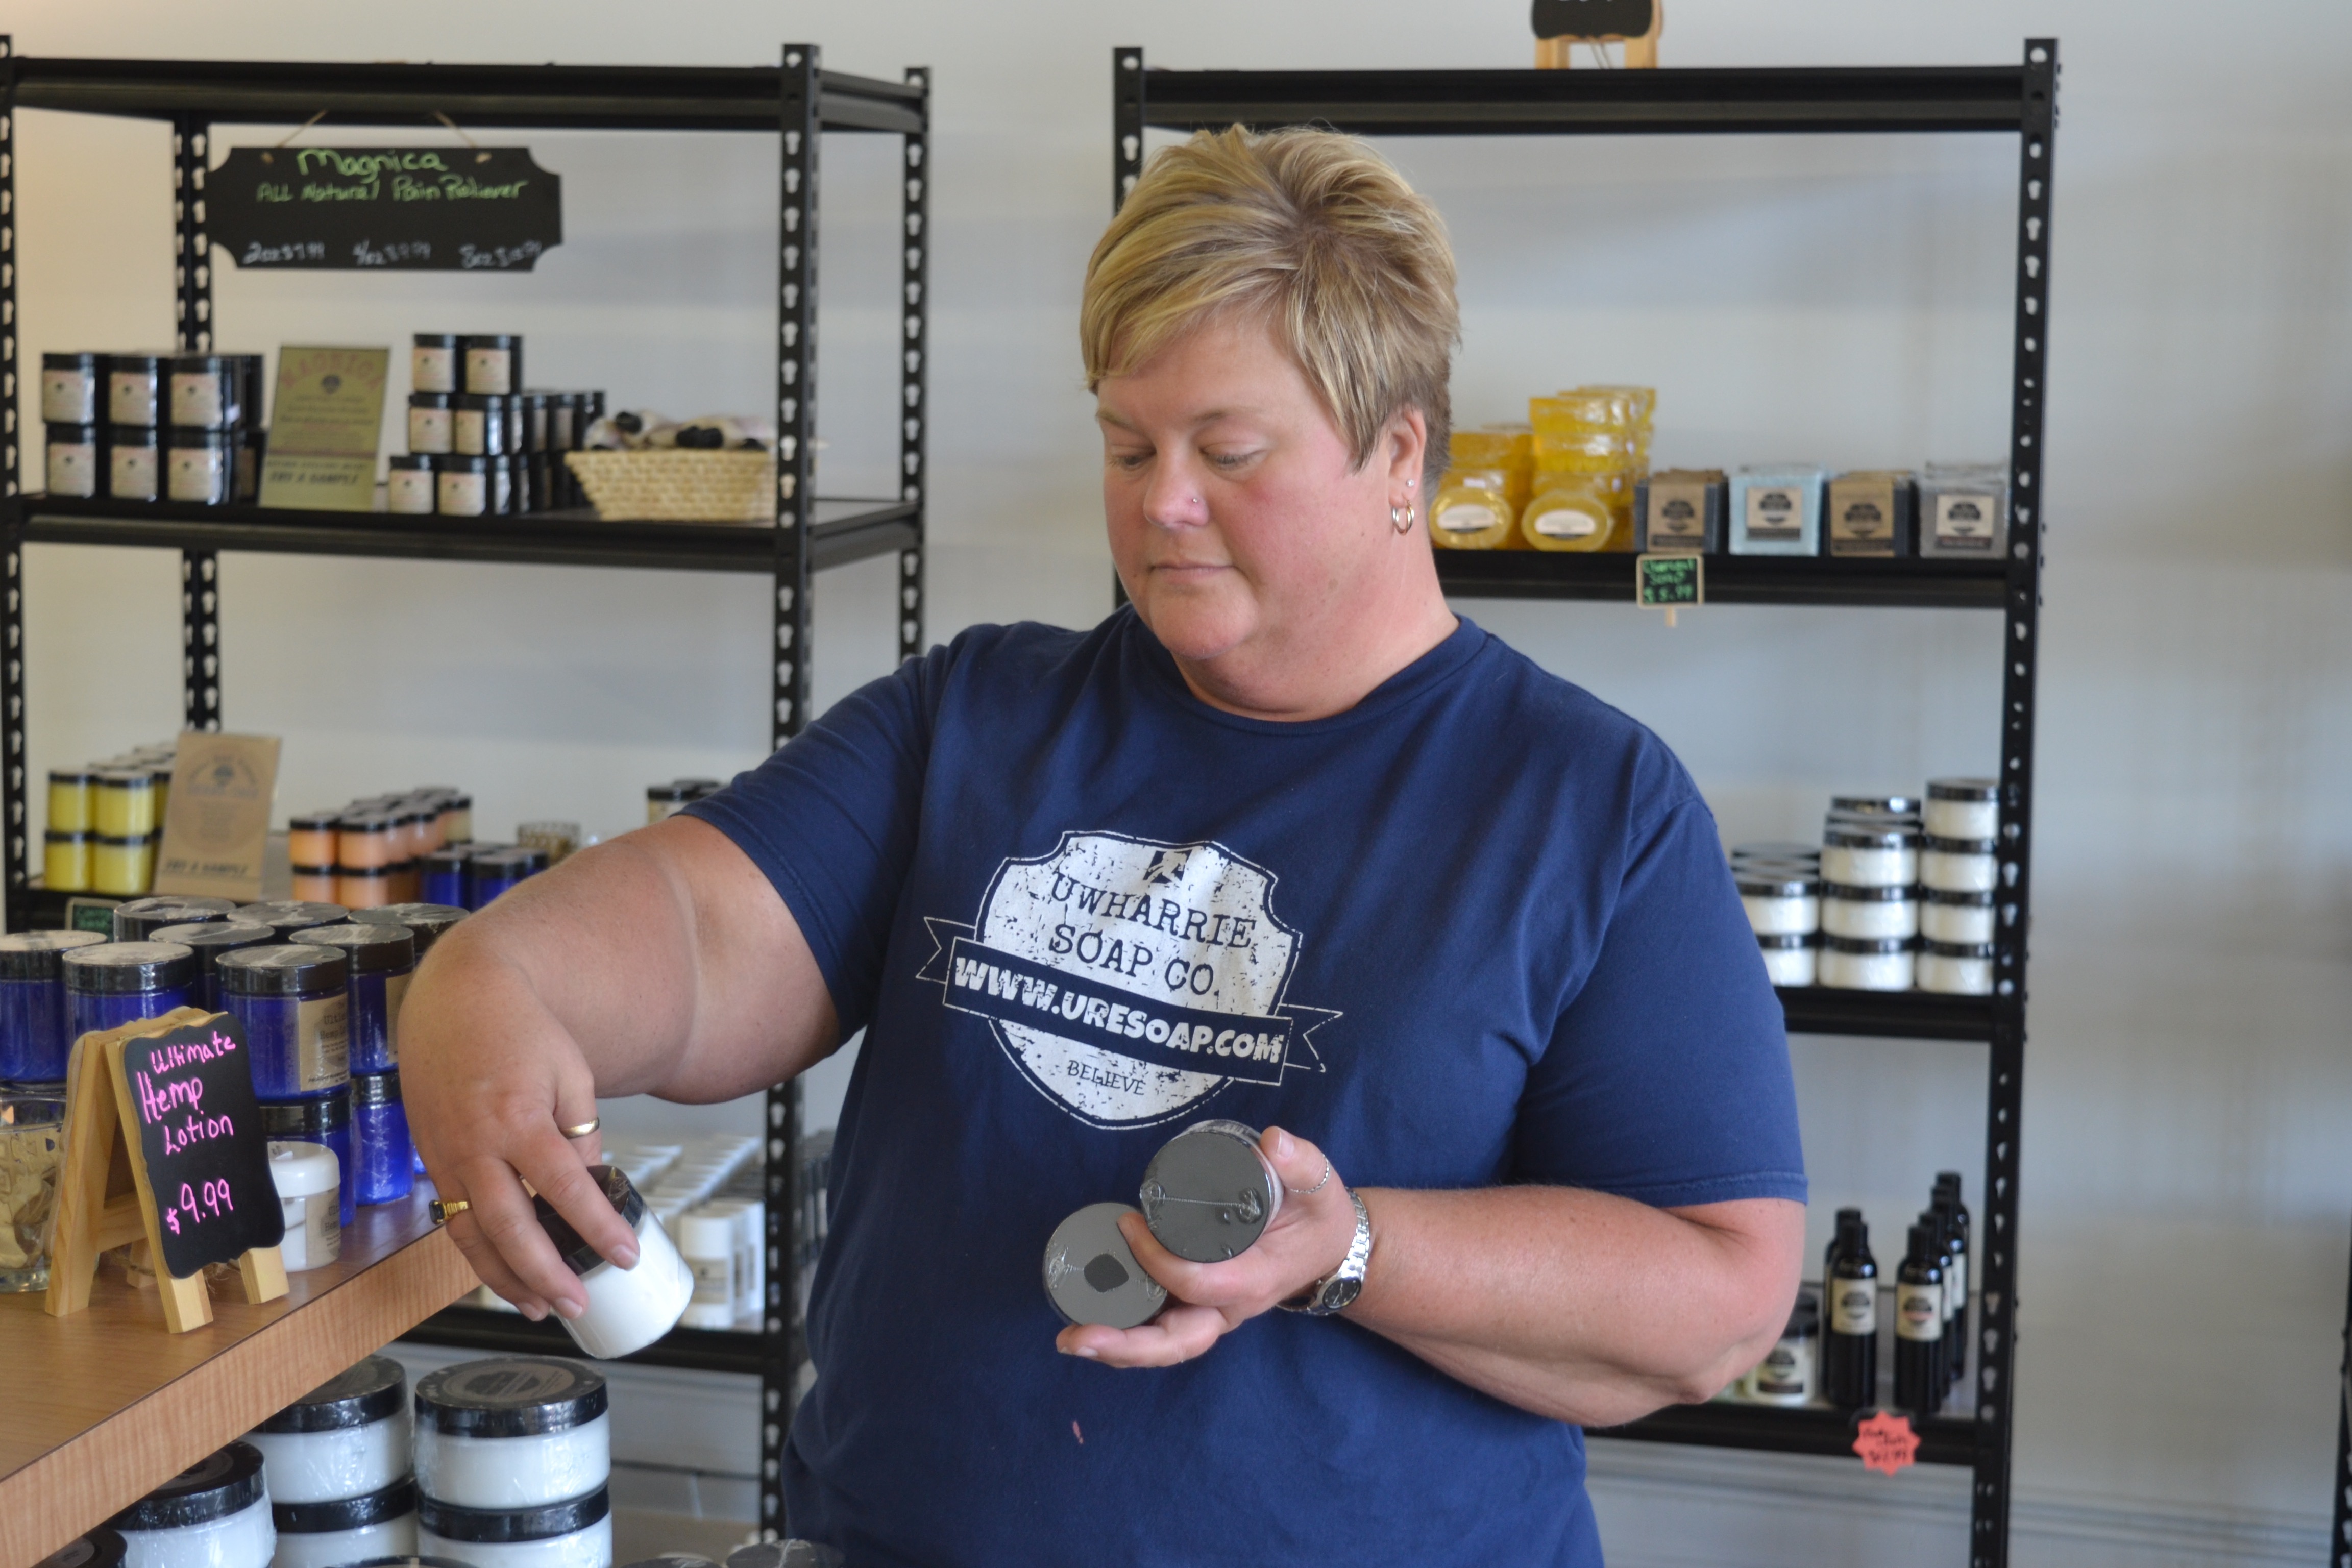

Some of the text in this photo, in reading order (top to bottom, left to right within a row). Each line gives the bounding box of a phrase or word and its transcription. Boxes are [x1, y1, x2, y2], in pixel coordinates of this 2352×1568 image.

[300, 179, 380, 202] Natural
[391, 174, 441, 201] Pain
[438, 175, 529, 201] Reliever
[1051, 872, 1257, 948] UWHARRIE
[1048, 924, 1220, 997] SOAP CO.
[954, 957, 1285, 1063] WWW.URESOAP.COM
[151, 1031, 236, 1074] Ultimate
[1067, 1060, 1147, 1096] BELIEVE
[137, 1071, 203, 1124] Hemp
[165, 1110, 234, 1156] Lotion
[166, 1178, 233, 1235] $9.99
